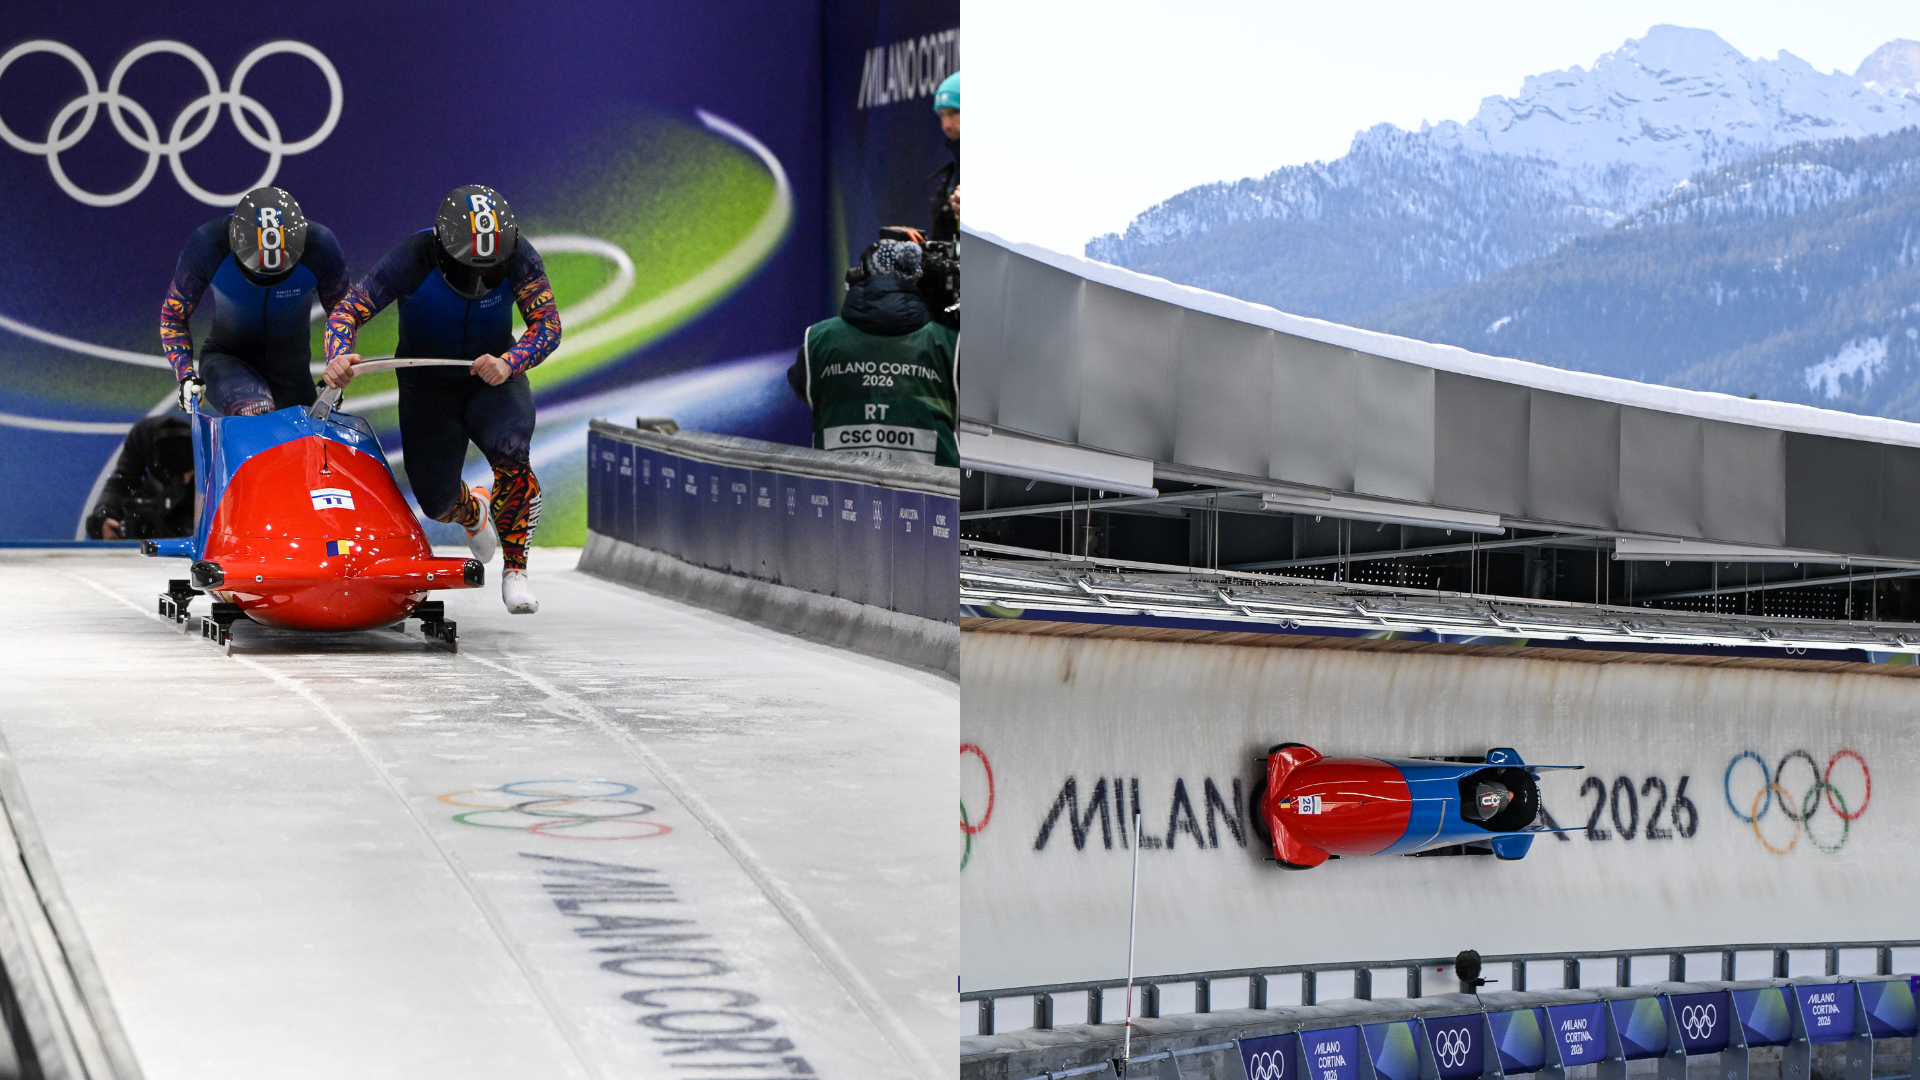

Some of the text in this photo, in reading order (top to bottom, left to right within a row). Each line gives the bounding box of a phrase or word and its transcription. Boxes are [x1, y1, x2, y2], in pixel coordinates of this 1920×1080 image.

[857, 38, 916, 110] MILANO
[470, 194, 495, 256] ROU
[261, 207, 281, 268] ROU
[820, 361, 942, 383] MILANO CORTINA
[862, 375, 894, 387] 2026
[864, 403, 890, 420] RT
[840, 429, 915, 446] CSC 0001
[1302, 797, 1312, 812] 26
[1580, 776, 1698, 841] 2026
[1033, 775, 1248, 851] MILAN
[518, 851, 733, 978] MILANO
[1807, 992, 1835, 1004] MILANO
[1812, 1004, 1840, 1015] CORTINA
[1560, 1018, 1587, 1031] MILANO
[1817, 1016, 1831, 1026] 2026
[1565, 1031, 1593, 1043] CORTINA
[1314, 1041, 1340, 1055] MILANO
[1570, 1044, 1583, 1055] 2026
[1318, 1055, 1346, 1068] CORTINA
[1323, 1070, 1338, 1080] 2026
